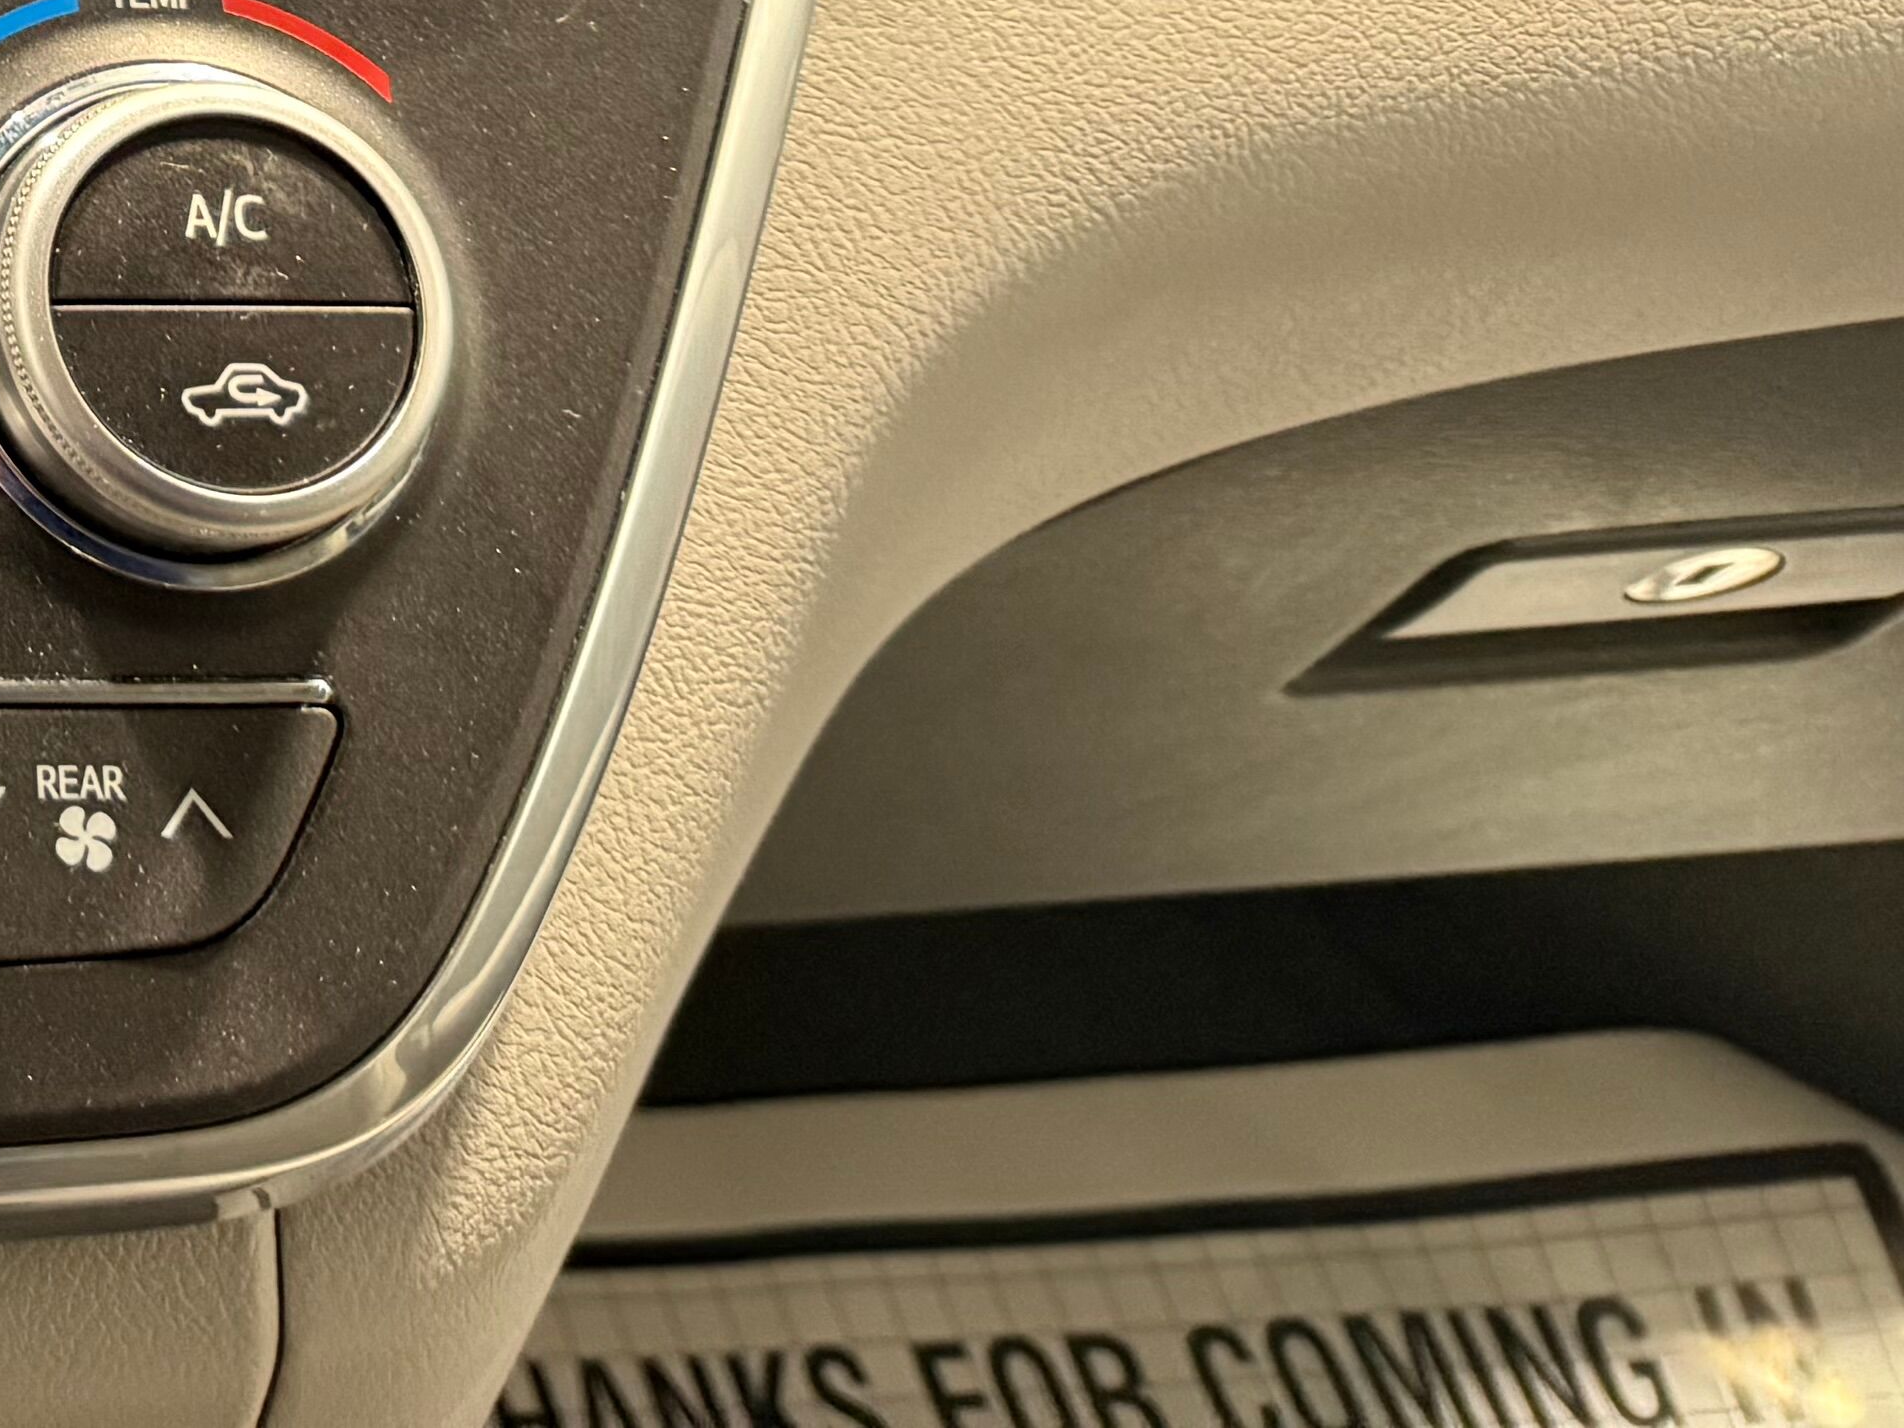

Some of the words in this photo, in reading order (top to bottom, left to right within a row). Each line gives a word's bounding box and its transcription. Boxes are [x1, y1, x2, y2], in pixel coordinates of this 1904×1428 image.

[185, 192, 268, 248] A/C
[36, 764, 126, 801] REAR
[1187, 1294, 1679, 1428] COMING
